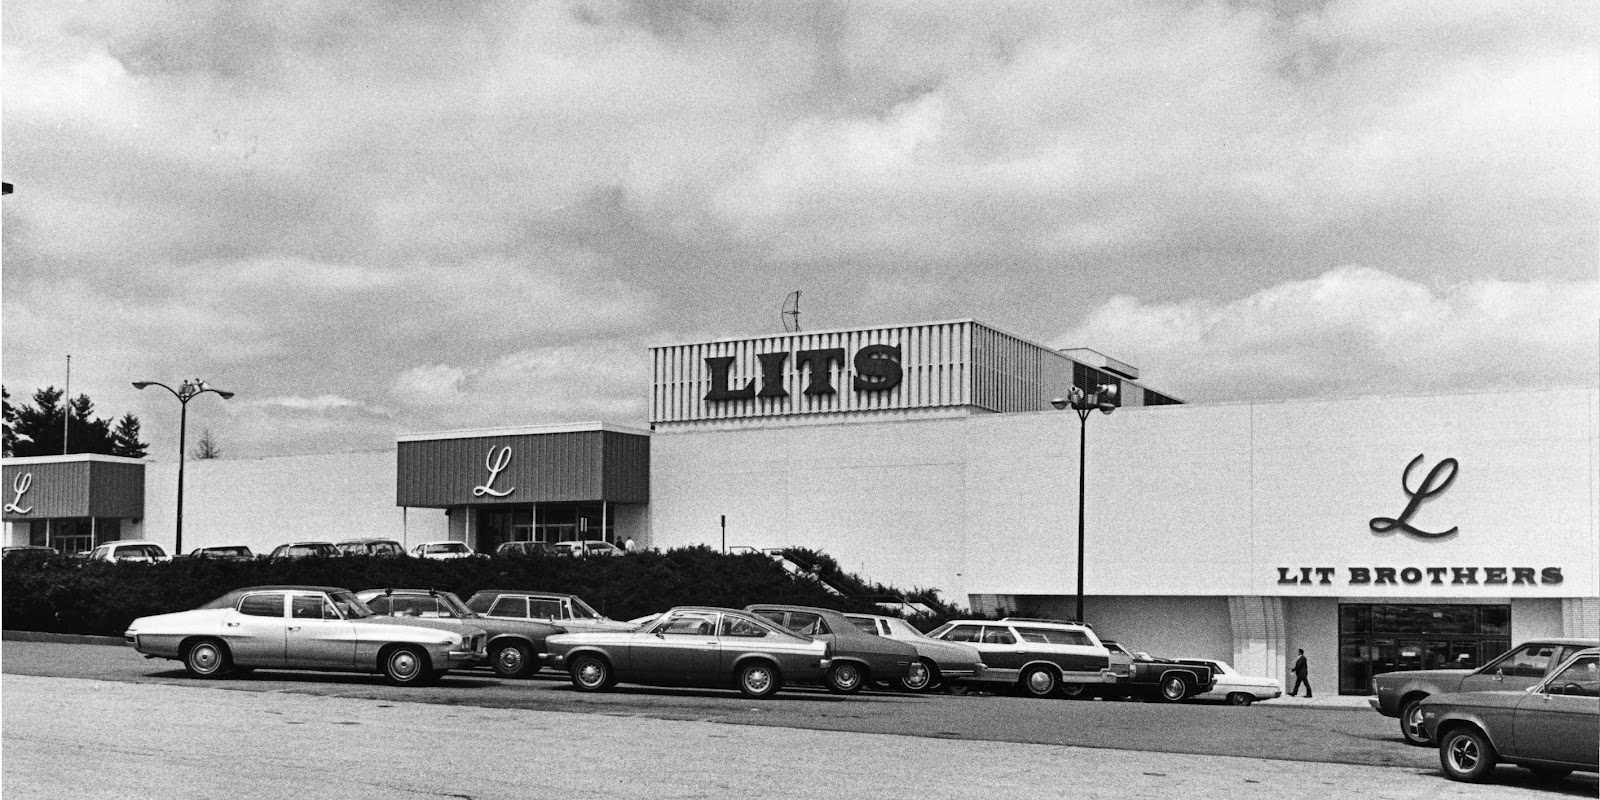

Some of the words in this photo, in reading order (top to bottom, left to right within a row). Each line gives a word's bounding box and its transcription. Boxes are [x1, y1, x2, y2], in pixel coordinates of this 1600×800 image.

[703, 344, 903, 401] LITS
[4, 472, 33, 514] L
[473, 446, 515, 497] L
[1369, 453, 1460, 539] L
[1277, 567, 1336, 585] LIT
[1349, 567, 1565, 585] BROTHERS
